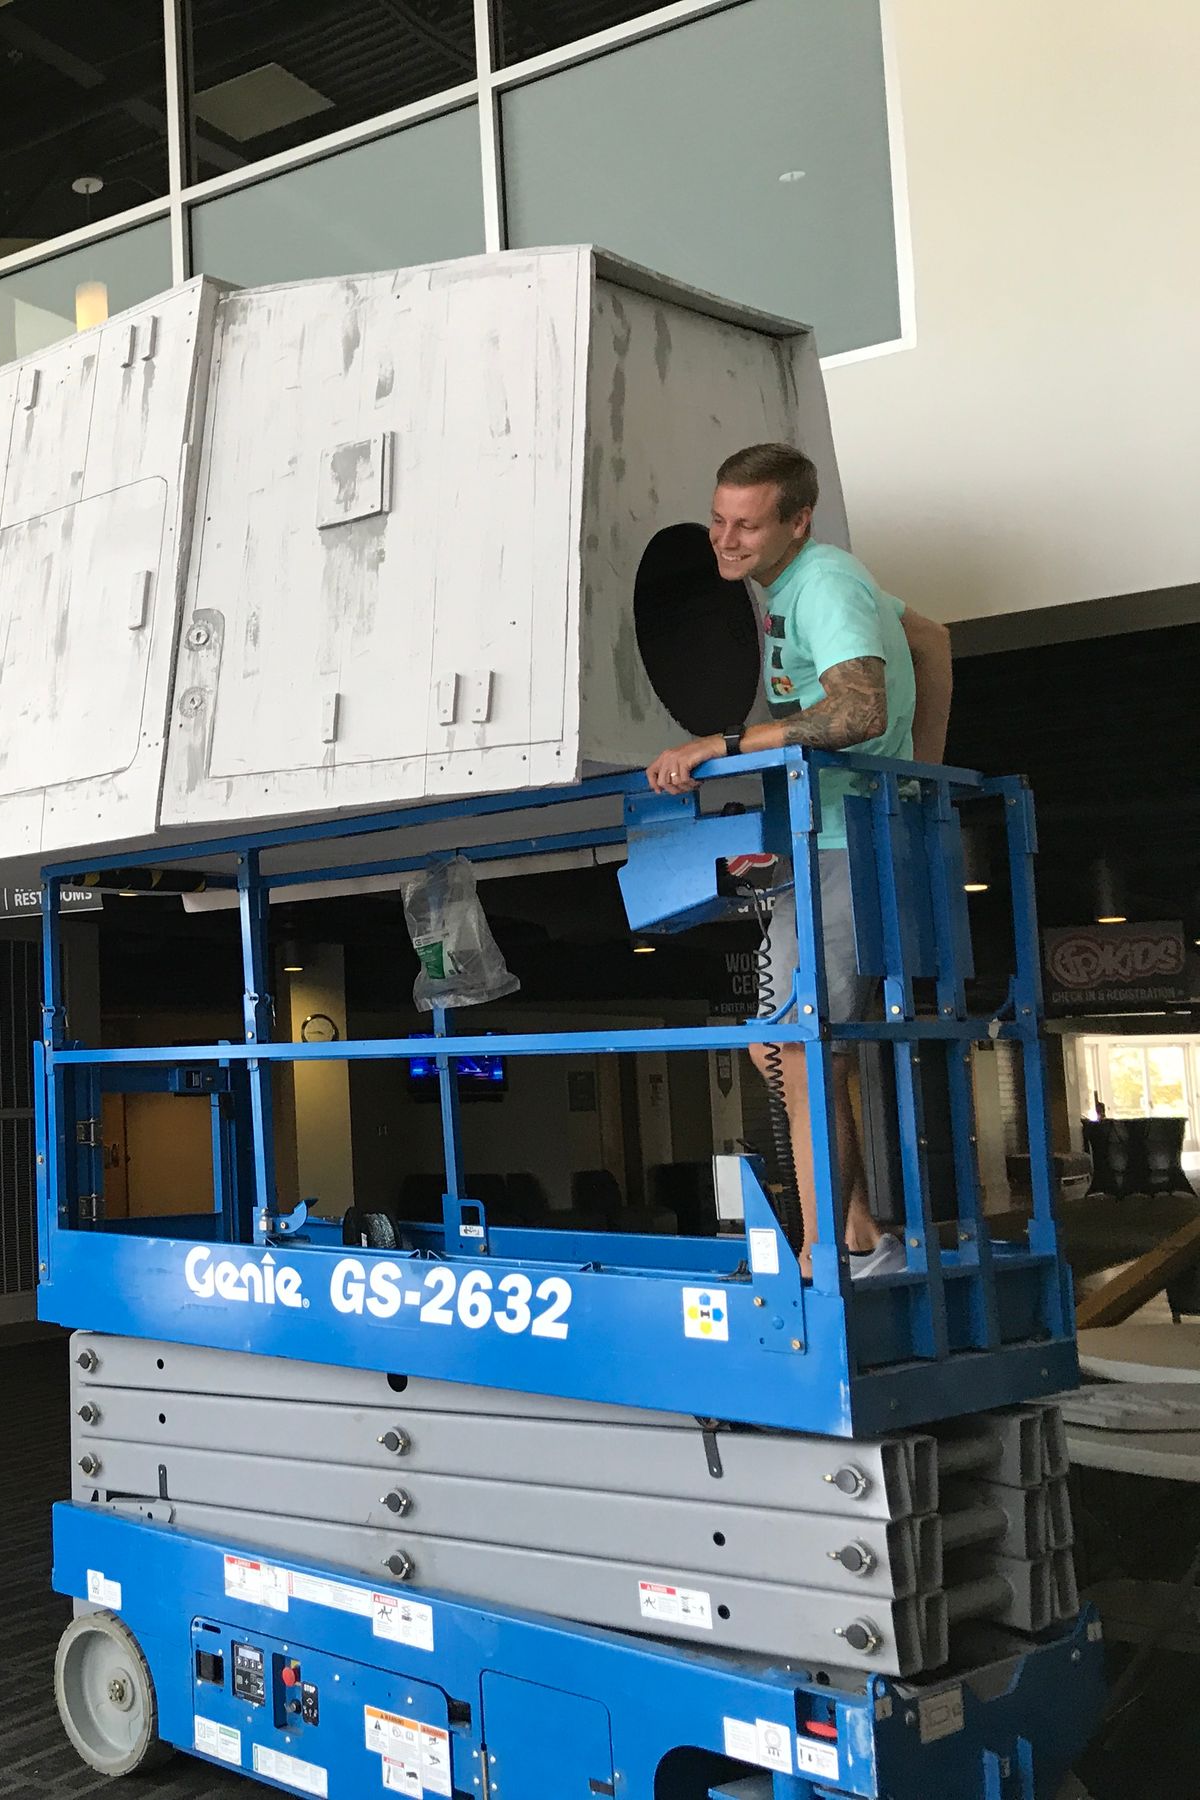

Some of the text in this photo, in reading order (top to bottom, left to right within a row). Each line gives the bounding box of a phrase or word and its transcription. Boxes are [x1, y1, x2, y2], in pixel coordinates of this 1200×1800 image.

[14, 890, 92, 907] RESTOMS
[185, 1246, 573, 1340] Genie GS-2632
